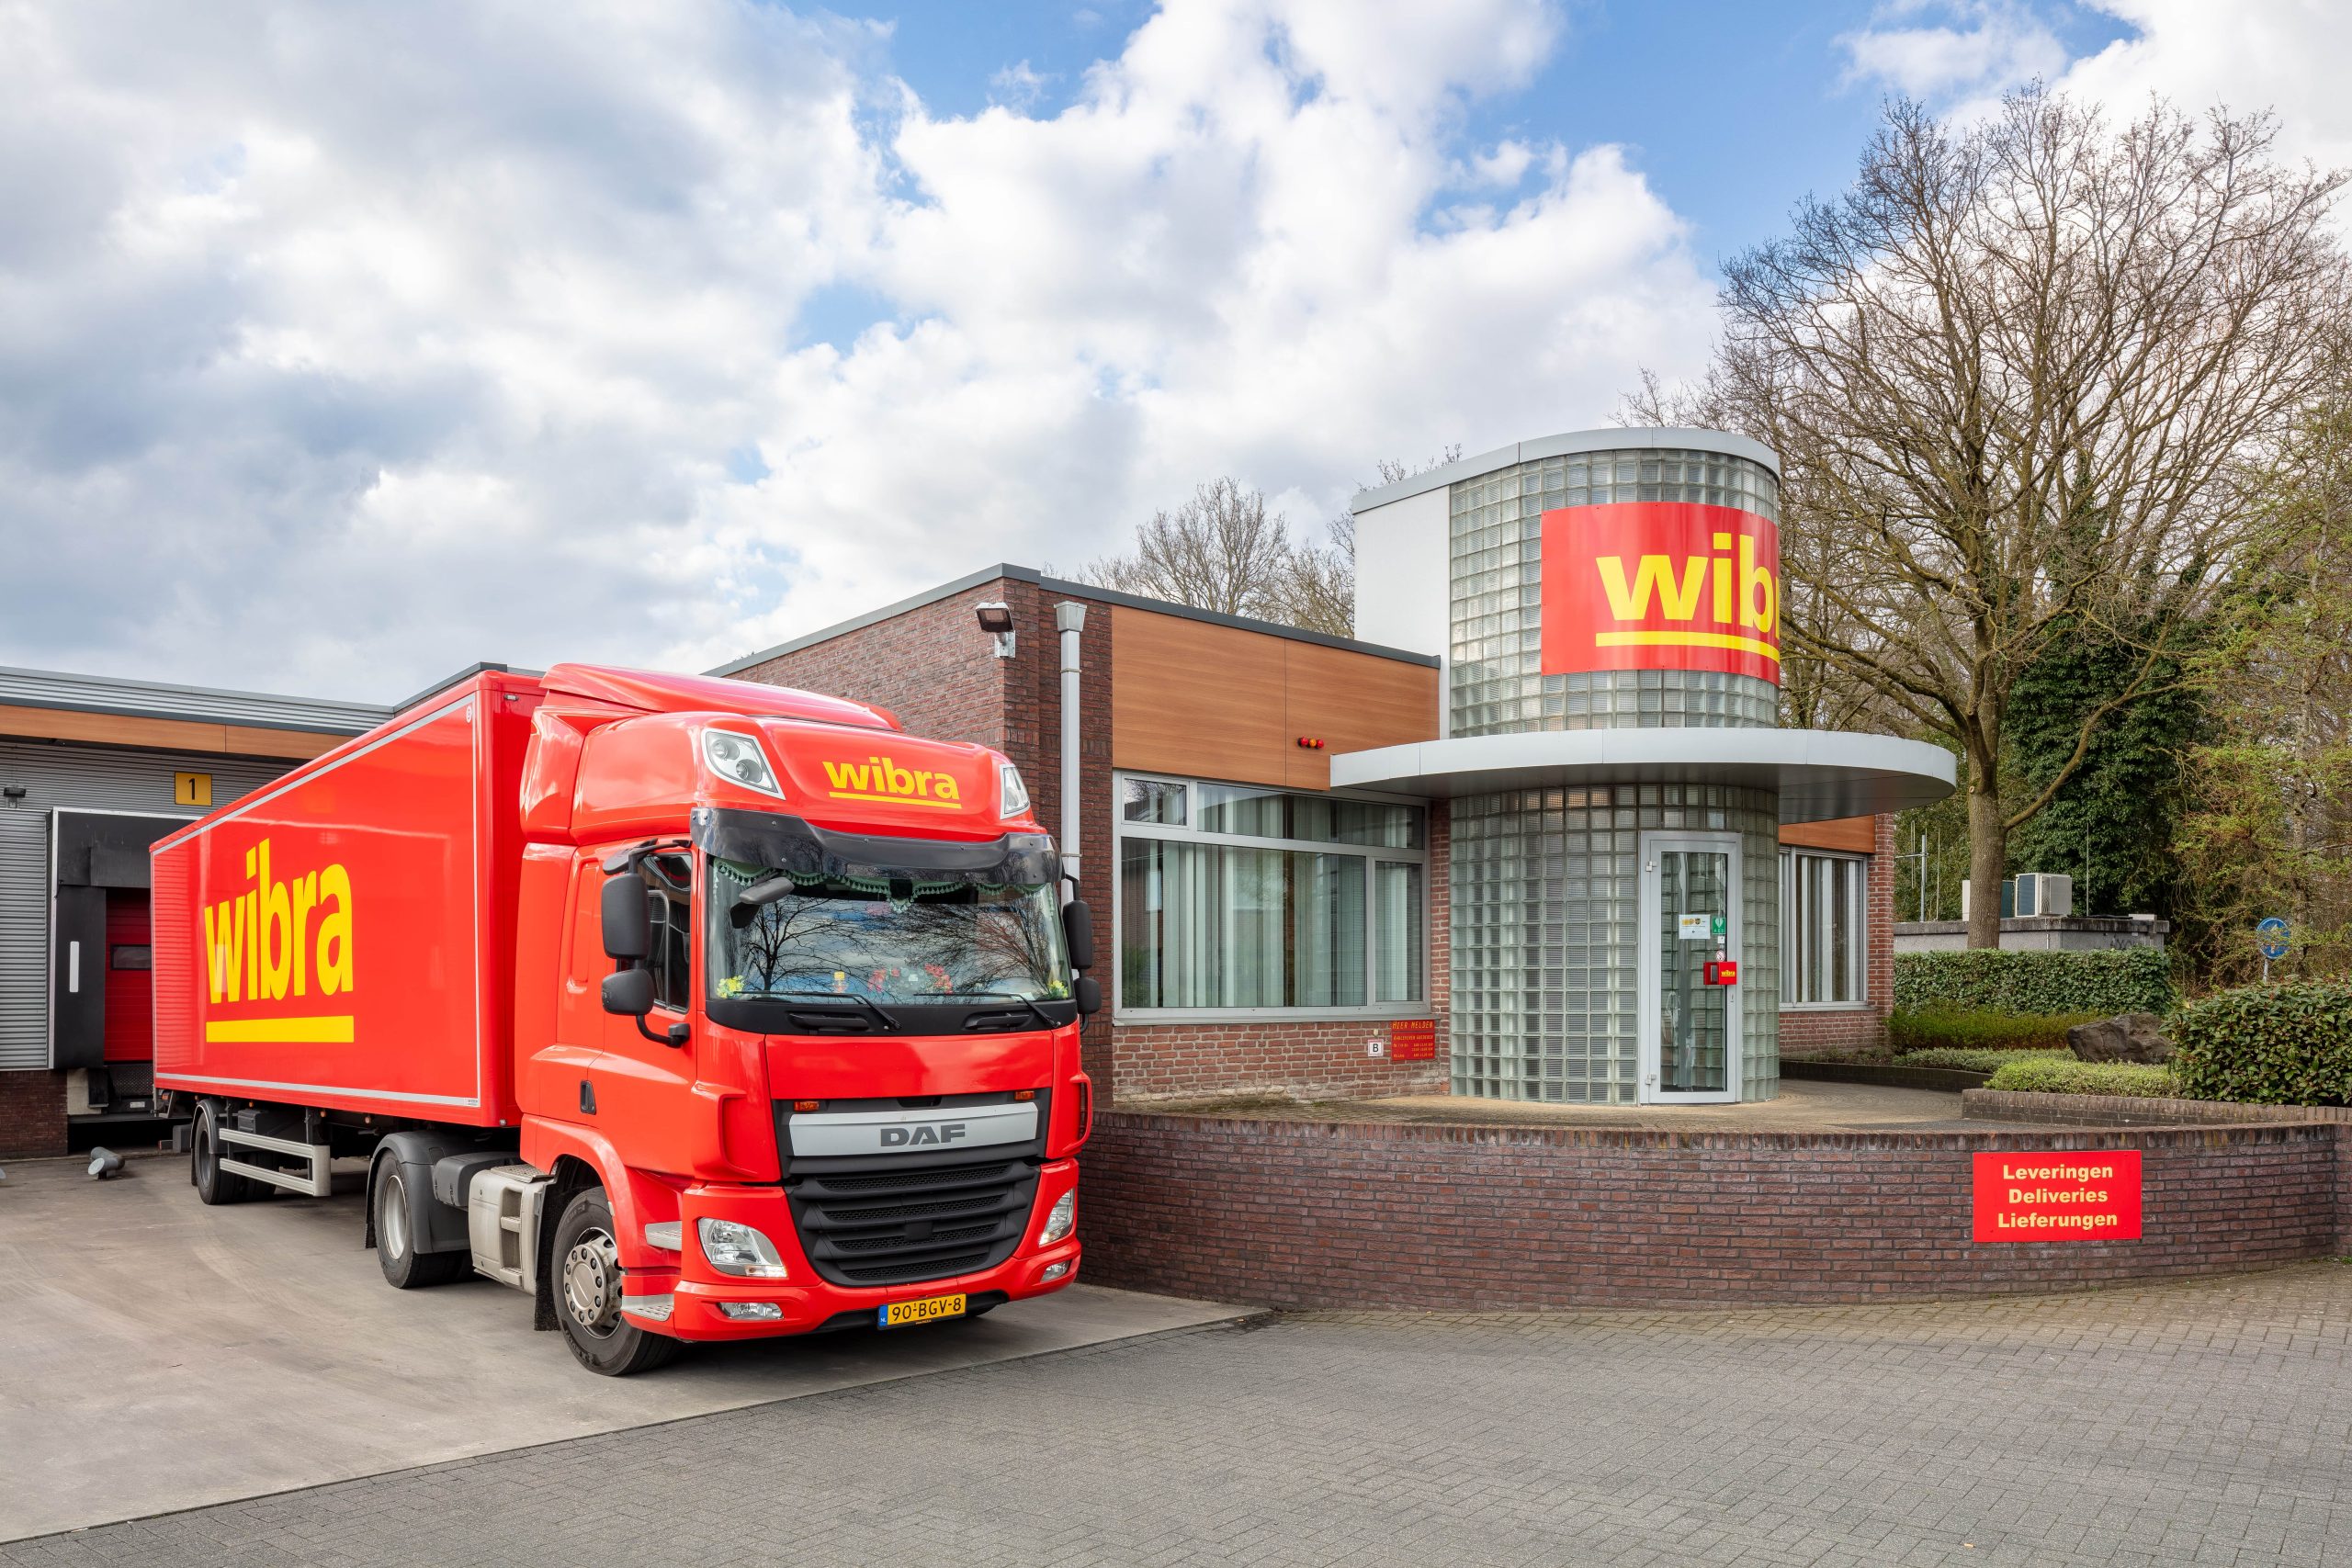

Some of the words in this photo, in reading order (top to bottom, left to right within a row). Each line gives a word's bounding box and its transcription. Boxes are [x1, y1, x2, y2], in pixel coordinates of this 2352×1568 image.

[821, 756, 960, 800] wibra
[188, 777, 196, 801] 1
[204, 838, 354, 1004] wibra
[1393, 1021, 1408, 1029] HIER
[1373, 1043, 1379, 1052] B
[880, 1124, 966, 1147] DAF
[2003, 1164, 2113, 1183] Leveringen
[2008, 1188, 2109, 1204] Deliveries
[1997, 1213, 2118, 1231] Lieferungen
[892, 1297, 961, 1321] 90-BGV-8
